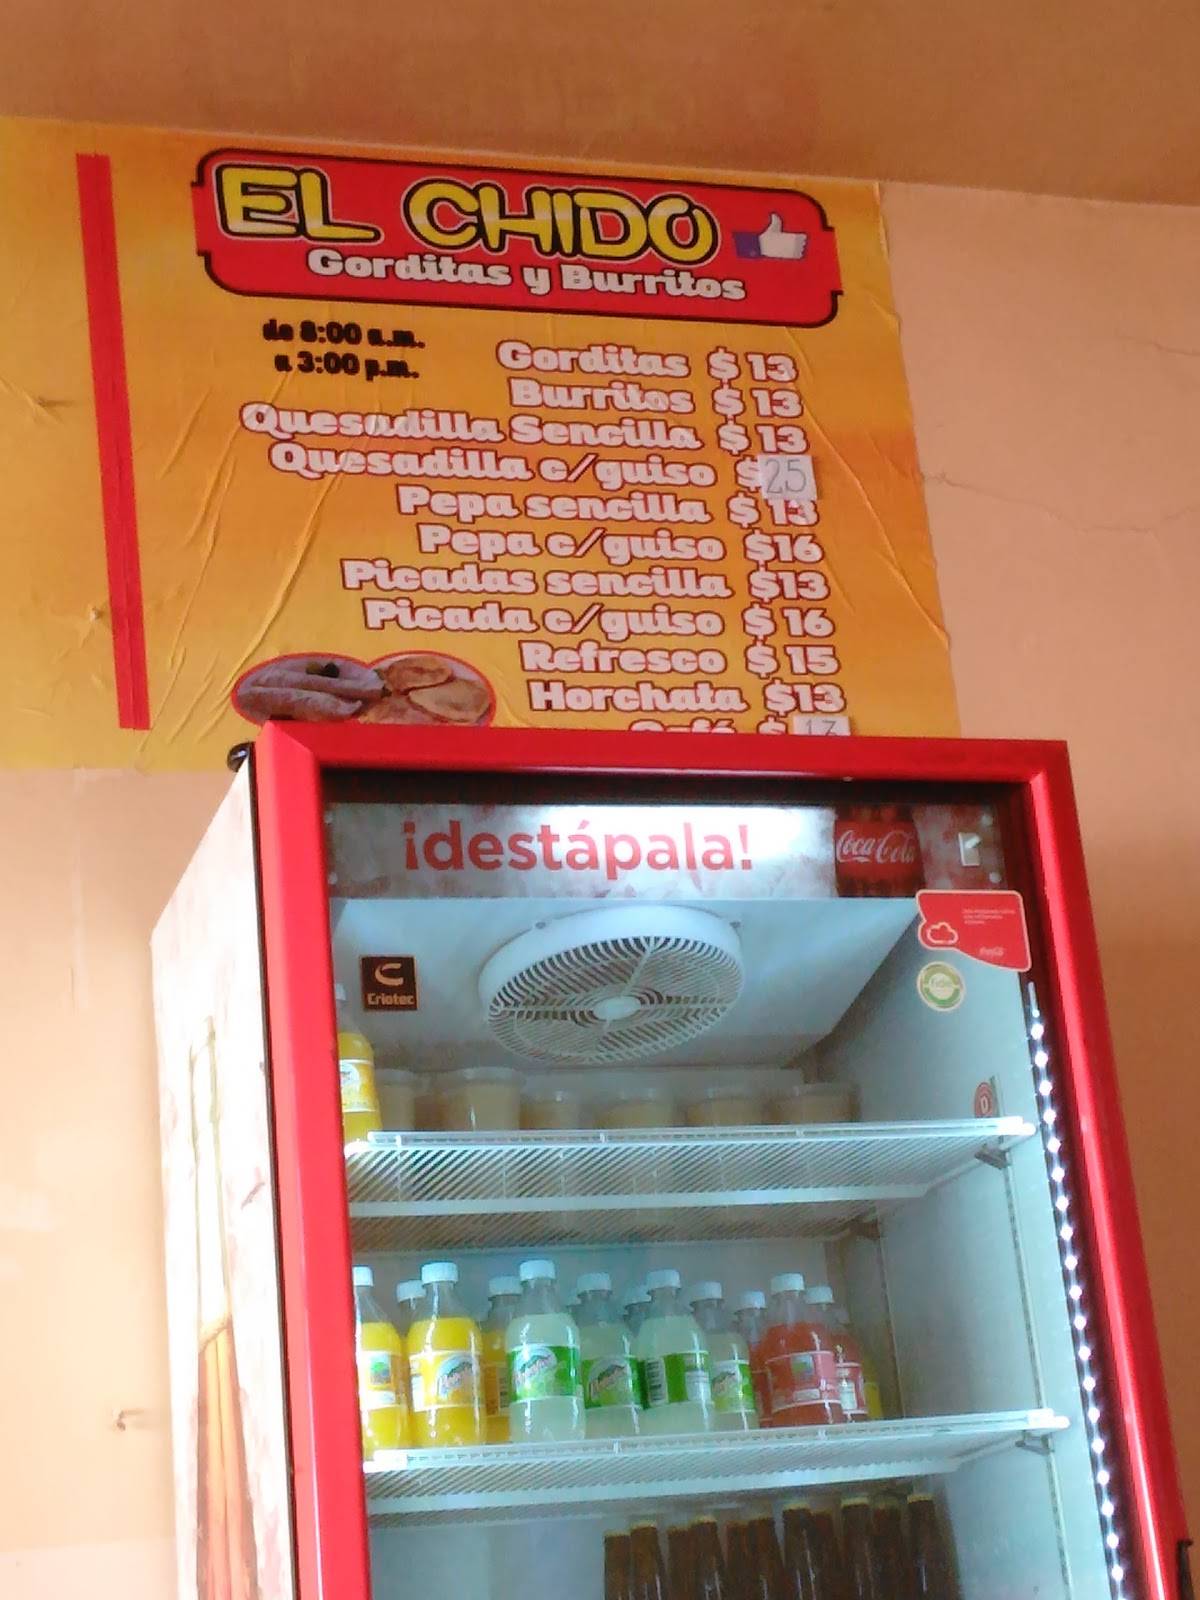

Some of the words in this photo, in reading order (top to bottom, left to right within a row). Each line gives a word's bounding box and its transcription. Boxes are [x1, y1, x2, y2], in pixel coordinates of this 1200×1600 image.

[215, 163, 384, 244] EL
[402, 178, 718, 265] CHIDO
[307, 249, 513, 287] Gorditas
[522, 265, 551, 296] y
[560, 263, 747, 301] Burritos
[262, 318, 295, 342] de
[300, 320, 363, 345] 8:00
[296, 350, 361, 376] 3:00
[364, 358, 420, 382] p.m.
[496, 339, 691, 377] Gorditas
[745, 353, 799, 382] 13
[508, 377, 696, 414] Burritos
[751, 388, 803, 418] 13
[240, 401, 506, 442] Quesadilla
[508, 413, 704, 450] Sencilla
[754, 423, 810, 454] 13
[268, 440, 535, 480] Quesadilla
[537, 453, 718, 491] c/guiso
[765, 458, 807, 493] 25
[396, 483, 523, 524] Pepa
[525, 490, 714, 523] sencilla
[416, 522, 544, 563] Pepa
[544, 526, 727, 566] c/guiso
[340, 557, 539, 595] Picadas
[544, 565, 736, 598] sencilla
[361, 596, 541, 634] Picada
[541, 602, 725, 642] c/guiso
[780, 606, 836, 638] 16
[517, 639, 728, 674] Refresco
[784, 644, 842, 675] 15
[526, 679, 751, 712] Horchata
[403, 819, 754, 881] ¡destápala!
